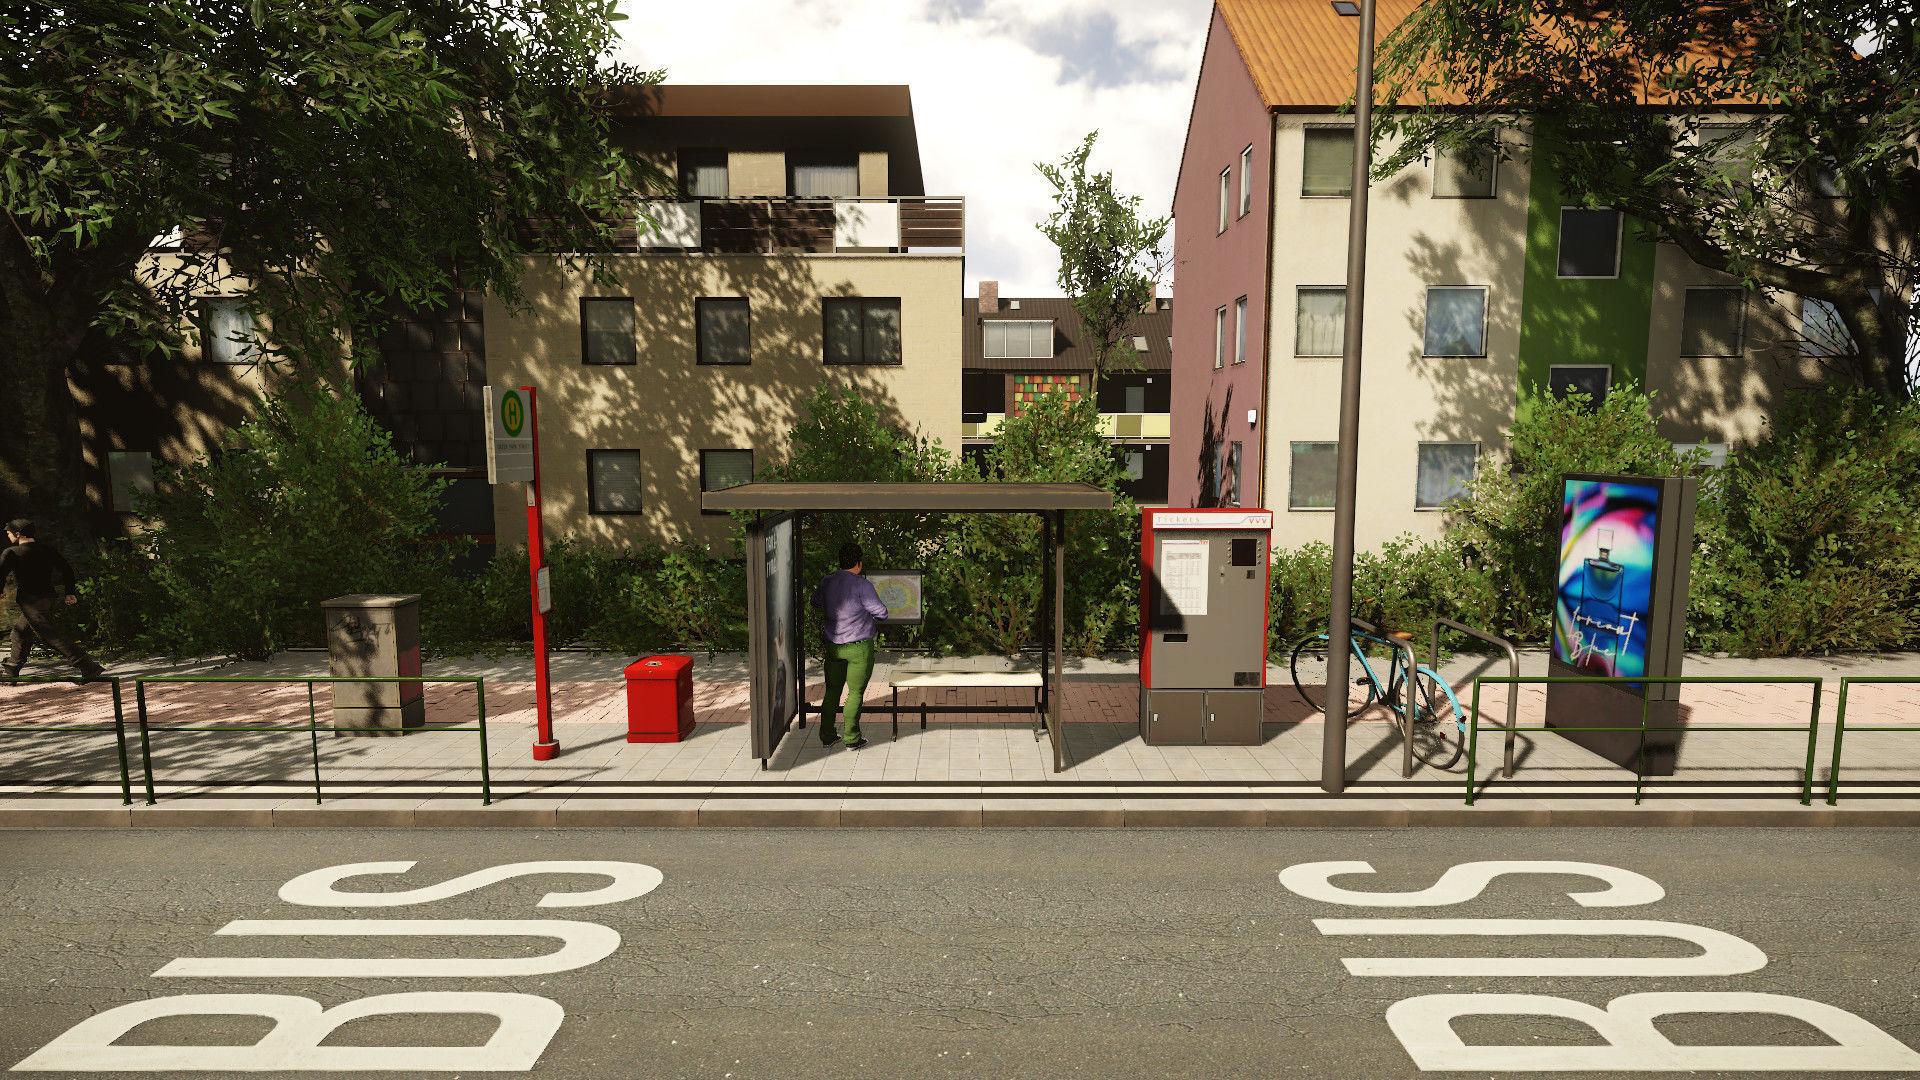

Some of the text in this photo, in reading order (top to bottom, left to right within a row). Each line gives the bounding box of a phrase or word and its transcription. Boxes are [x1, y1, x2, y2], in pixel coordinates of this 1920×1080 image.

[508, 401, 518, 425] H
[1157, 515, 1200, 523] Tickets
[9, 861, 663, 1071] BUS
[1279, 861, 1920, 1071] BUS
